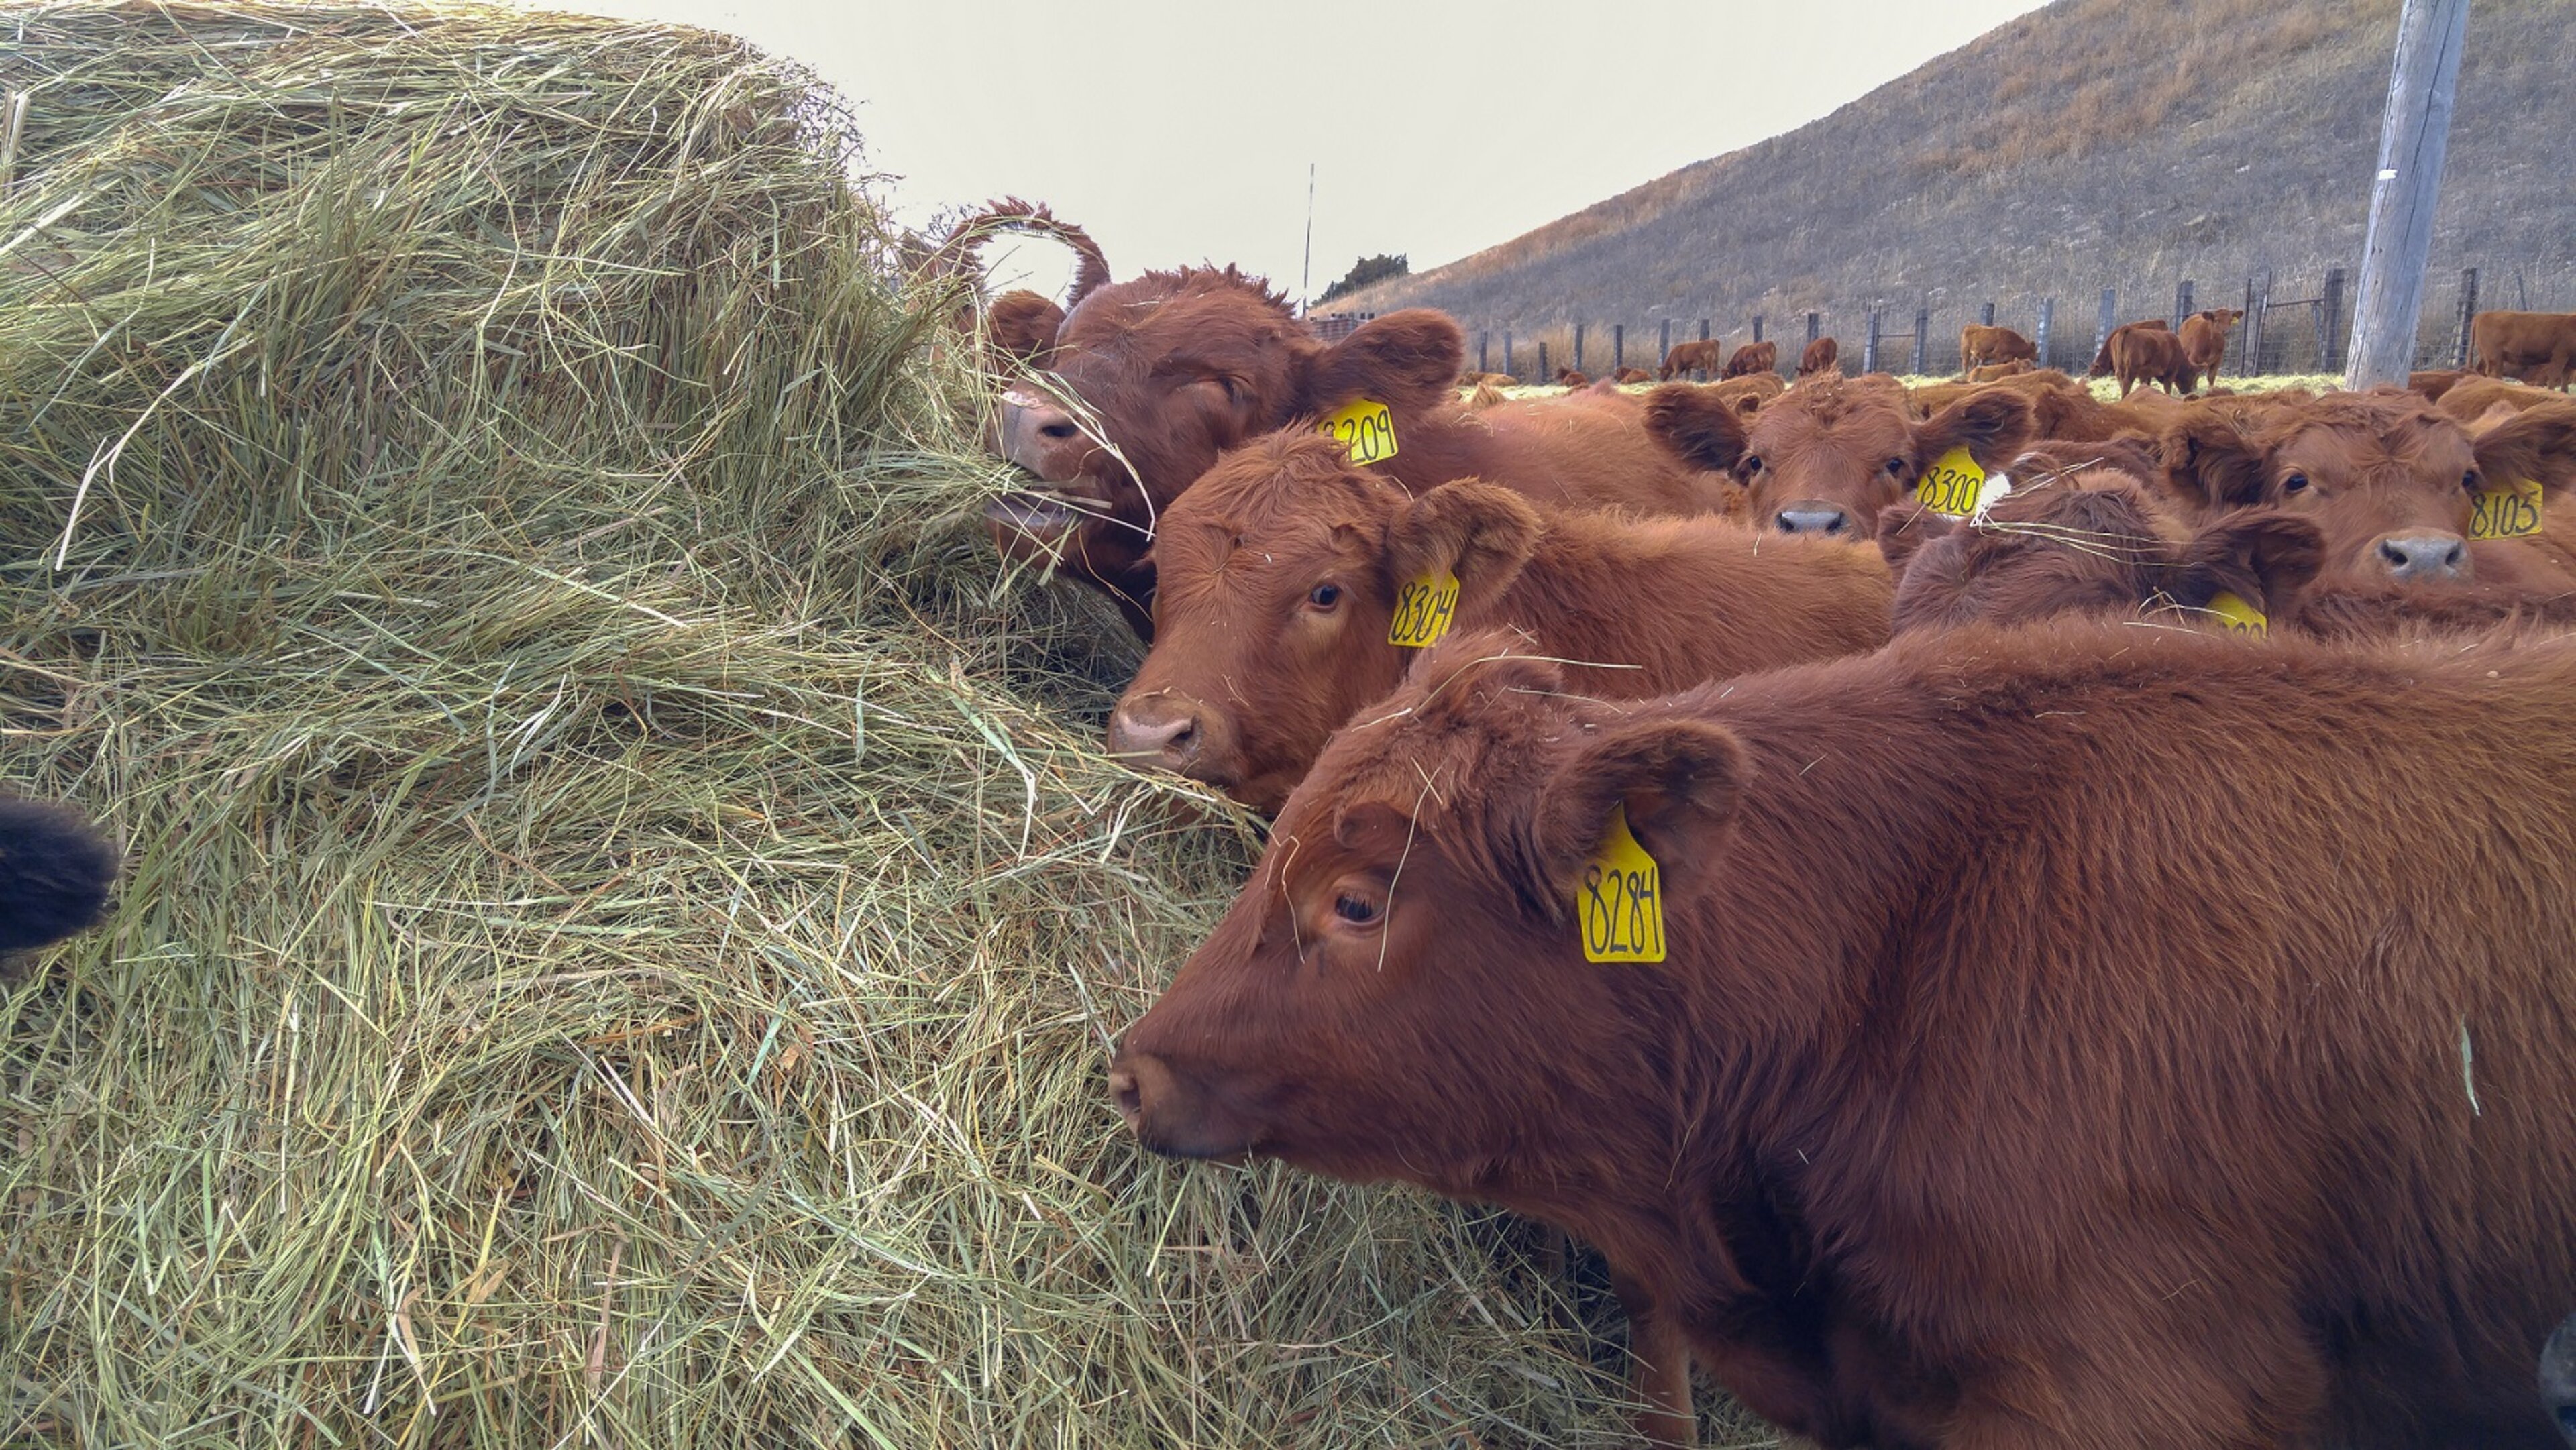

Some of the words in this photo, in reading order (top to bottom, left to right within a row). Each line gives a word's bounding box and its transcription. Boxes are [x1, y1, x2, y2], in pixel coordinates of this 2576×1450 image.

[1921, 466, 1979, 513] 8300
[2470, 490, 2538, 537] 8105
[1391, 581, 1456, 643] 8304
[1584, 864, 1660, 954] 8284
